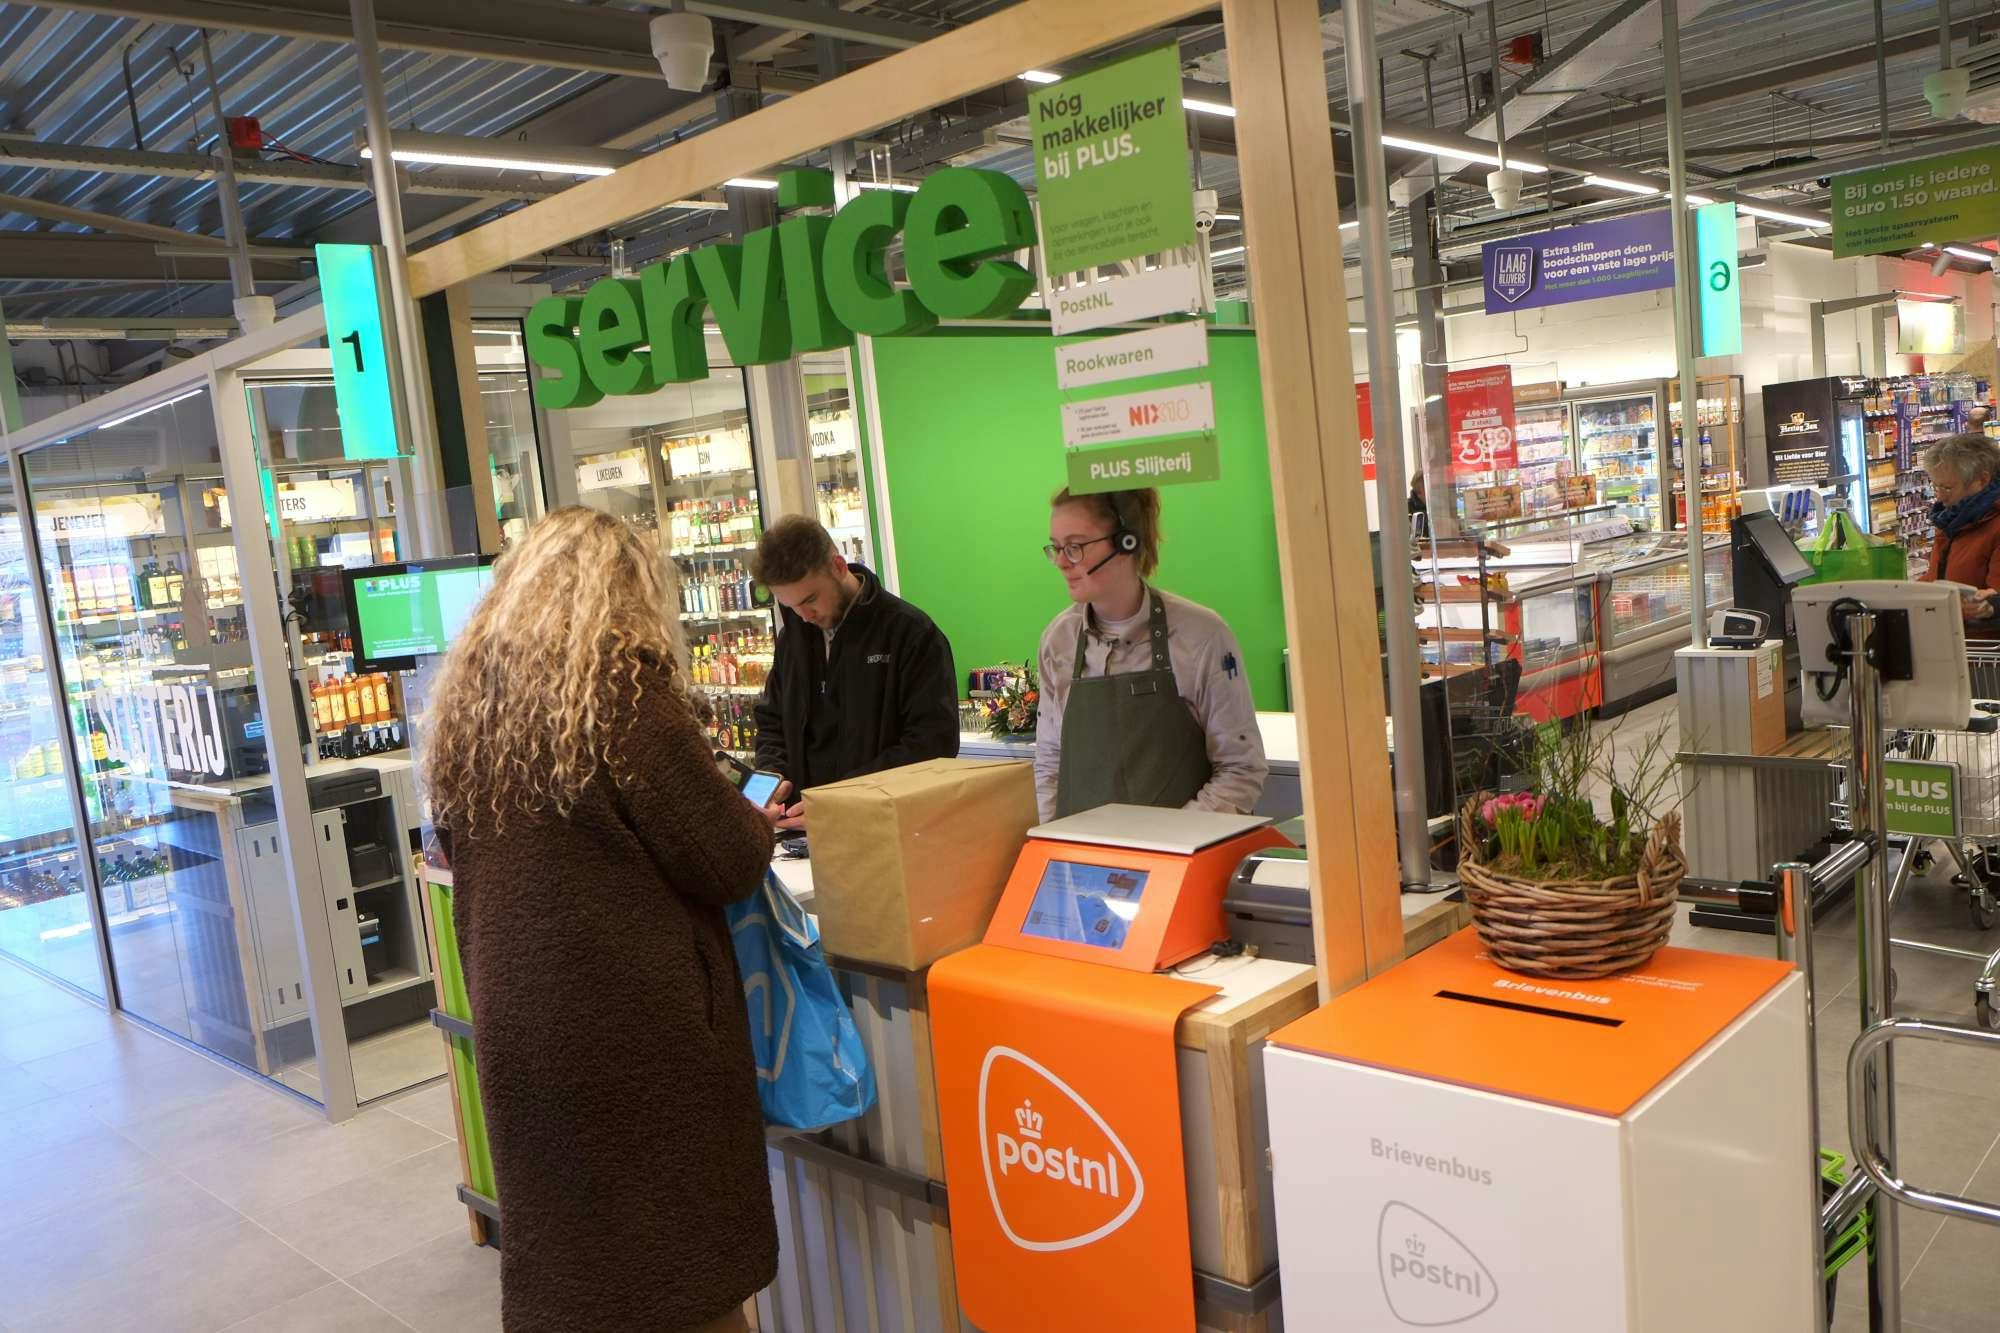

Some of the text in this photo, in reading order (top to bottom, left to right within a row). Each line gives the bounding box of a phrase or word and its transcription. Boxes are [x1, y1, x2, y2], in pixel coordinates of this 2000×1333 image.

[1039, 92, 1082, 122] Nóg
[1042, 96, 1165, 150] makkelijker
[1044, 134, 1141, 179] bij PLUS.
[1844, 163, 1991, 200] Bij ons is iedere
[1844, 178, 1999, 217] euro 1.50 waard.
[1499, 253, 1527, 273] LAAG
[1542, 241, 1594, 258] Extra slim
[1543, 242, 1652, 270] boodschappen doen
[1498, 271, 1526, 285] BLIJVERS
[1543, 250, 1676, 280] voor een vaste lage prijs
[527, 166, 1038, 409] service
[1060, 292, 1113, 316] PostNL
[341, 330, 365, 373] 1
[1066, 347, 1154, 375] Rookwaren
[810, 430, 836, 447] VODKA
[698, 452, 711, 465] GIN
[1090, 451, 1192, 480] PLUS Slijterij
[596, 465, 623, 482] LIKEUREN
[279, 497, 307, 513] TERS
[378, 576, 421, 592] PLUS
[1884, 778, 1948, 800] PLUS
[1895, 802, 1908, 813] bij
[1910, 803, 1922, 813] de
[1492, 979, 1613, 1005] Brievenbus
[997, 1133, 1120, 1198] postnl
[1370, 1137, 1493, 1186] Brievenbus
[1390, 1251, 1482, 1298] postnl
